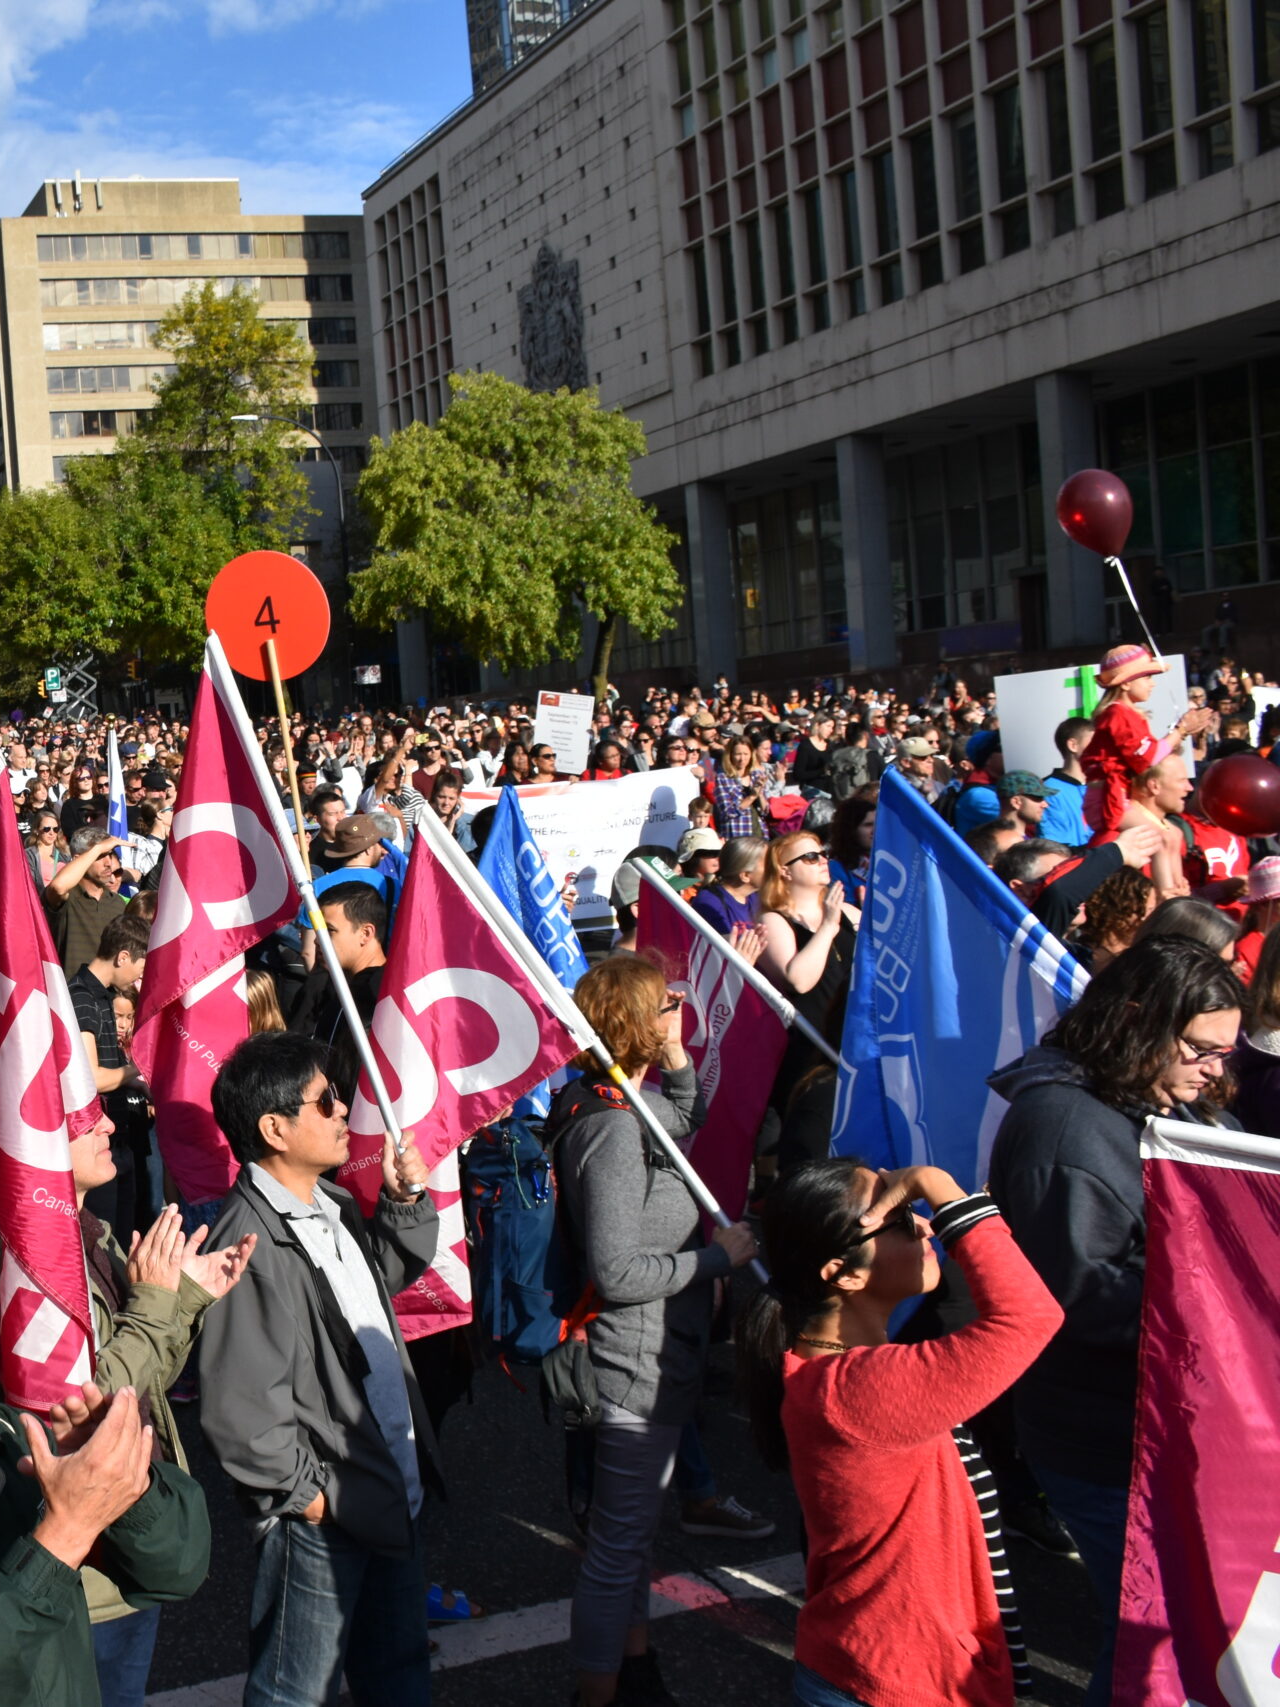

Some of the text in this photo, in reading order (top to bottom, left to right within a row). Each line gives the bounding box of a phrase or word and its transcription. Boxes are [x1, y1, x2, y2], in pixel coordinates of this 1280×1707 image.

[254, 595, 281, 634] 4
[47, 669, 58, 682] P
[623, 816, 642, 826] AND
[644, 811, 677, 824] FUTURE
[189, 1040, 206, 1053] of
